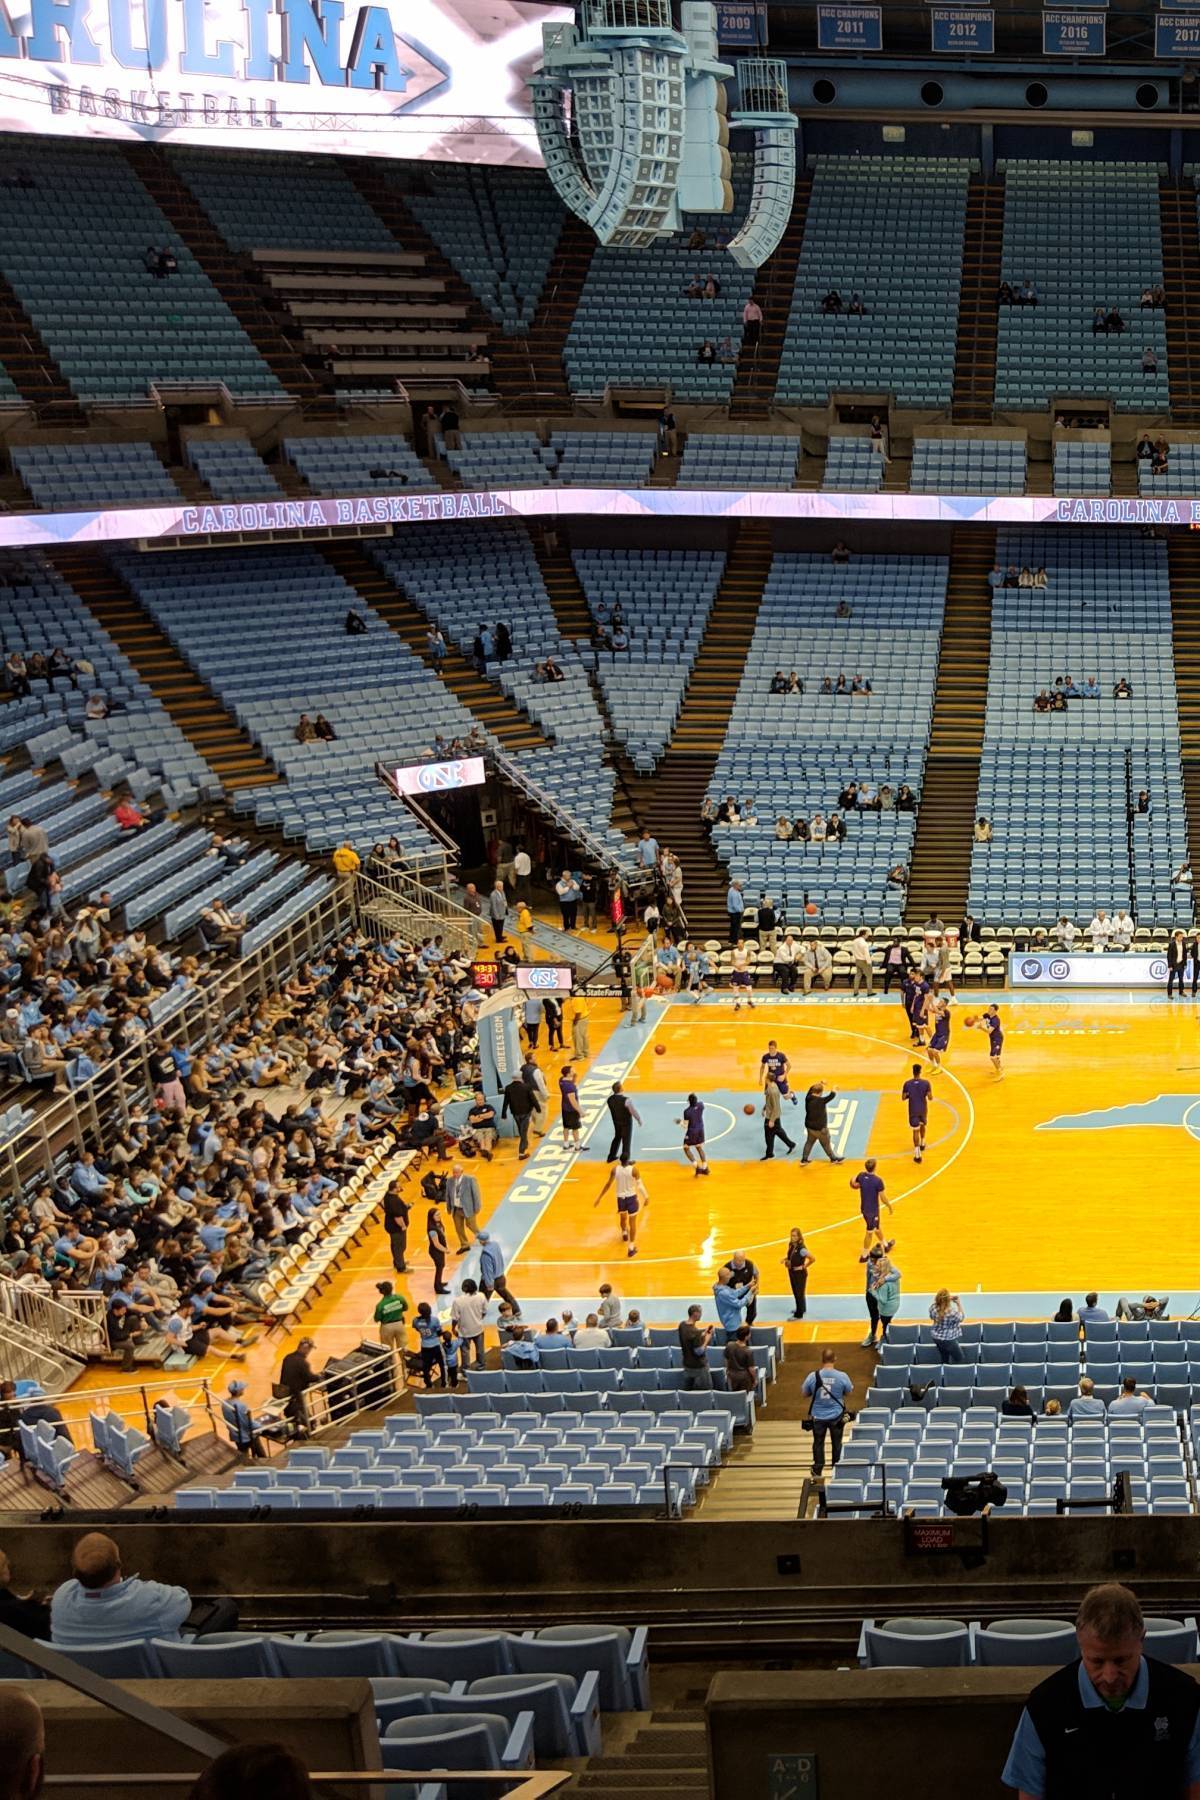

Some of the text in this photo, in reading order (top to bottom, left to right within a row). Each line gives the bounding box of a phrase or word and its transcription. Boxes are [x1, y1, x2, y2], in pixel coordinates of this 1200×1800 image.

[821, 8, 879, 20] ACC CHAMPIONS
[934, 11, 992, 22] ACC CHAMPIONS
[1045, 14, 1103, 24] ACC CHAMPIONS
[722, 17, 751, 29] 2009
[837, 20, 864, 33] 2011
[1159, 17, 1174, 26] ACC
[949, 24, 977, 36] 2012
[1060, 26, 1088, 39] 2016
[1175, 29, 1200, 41] 2017
[0, 0, 406, 92] ROLINA
[49, 84, 283, 129] BASKETBALL
[182, 492, 506, 534] CAROLINA BASKETBALL
[1056, 500, 1180, 523] CAROLINA
